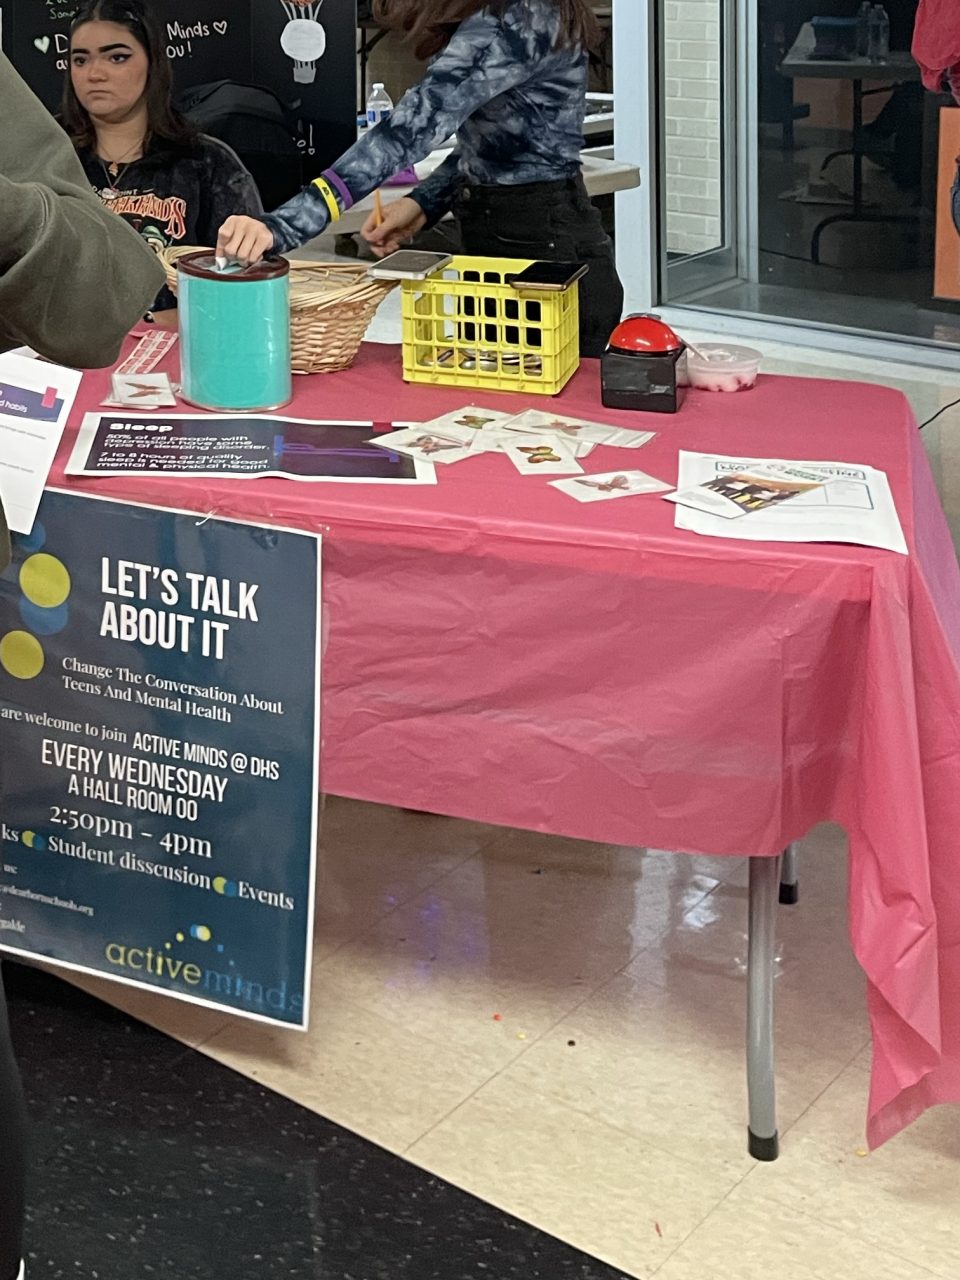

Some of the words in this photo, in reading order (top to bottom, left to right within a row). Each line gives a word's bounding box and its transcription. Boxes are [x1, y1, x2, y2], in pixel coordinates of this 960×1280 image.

[166, 20, 210, 40] Minds
[196, 454, 242, 462] quality
[101, 556, 179, 606] LET'S
[185, 572, 260, 622] TALK
[99, 601, 195, 653] ABOUT
[202, 619, 230, 660] IT
[62, 656, 113, 681] Change
[115, 666, 142, 684] The
[145, 673, 237, 705] Conversation
[240, 693, 284, 714] About
[62, 675, 101, 696] Teens
[104, 684, 132, 702] And
[135, 690, 182, 712] Mental
[185, 700, 231, 723] Health
[1, 707, 22, 721] are
[25, 712, 82, 734] welcome
[85, 722, 99, 737] to
[100, 725, 127, 744] join
[133, 731, 180, 759] ACTIVE
[184, 741, 227, 769] MINDS
[230, 752, 248, 774] @
[250, 756, 280, 781] DHS
[41, 738, 104, 775] EVERY
[107, 752, 228, 803] WEDNESDAY
[68, 773, 80, 796] A
[83, 776, 123, 806] HALL
[126, 786, 172, 816] ROOM
[49, 806, 134, 840] 2:50pm
[159, 831, 213, 859] 4pm
[1, 823, 19, 843] ks
[48, 835, 116, 867] Student
[119, 851, 211, 890] disscusion
[237, 880, 294, 911] Events
